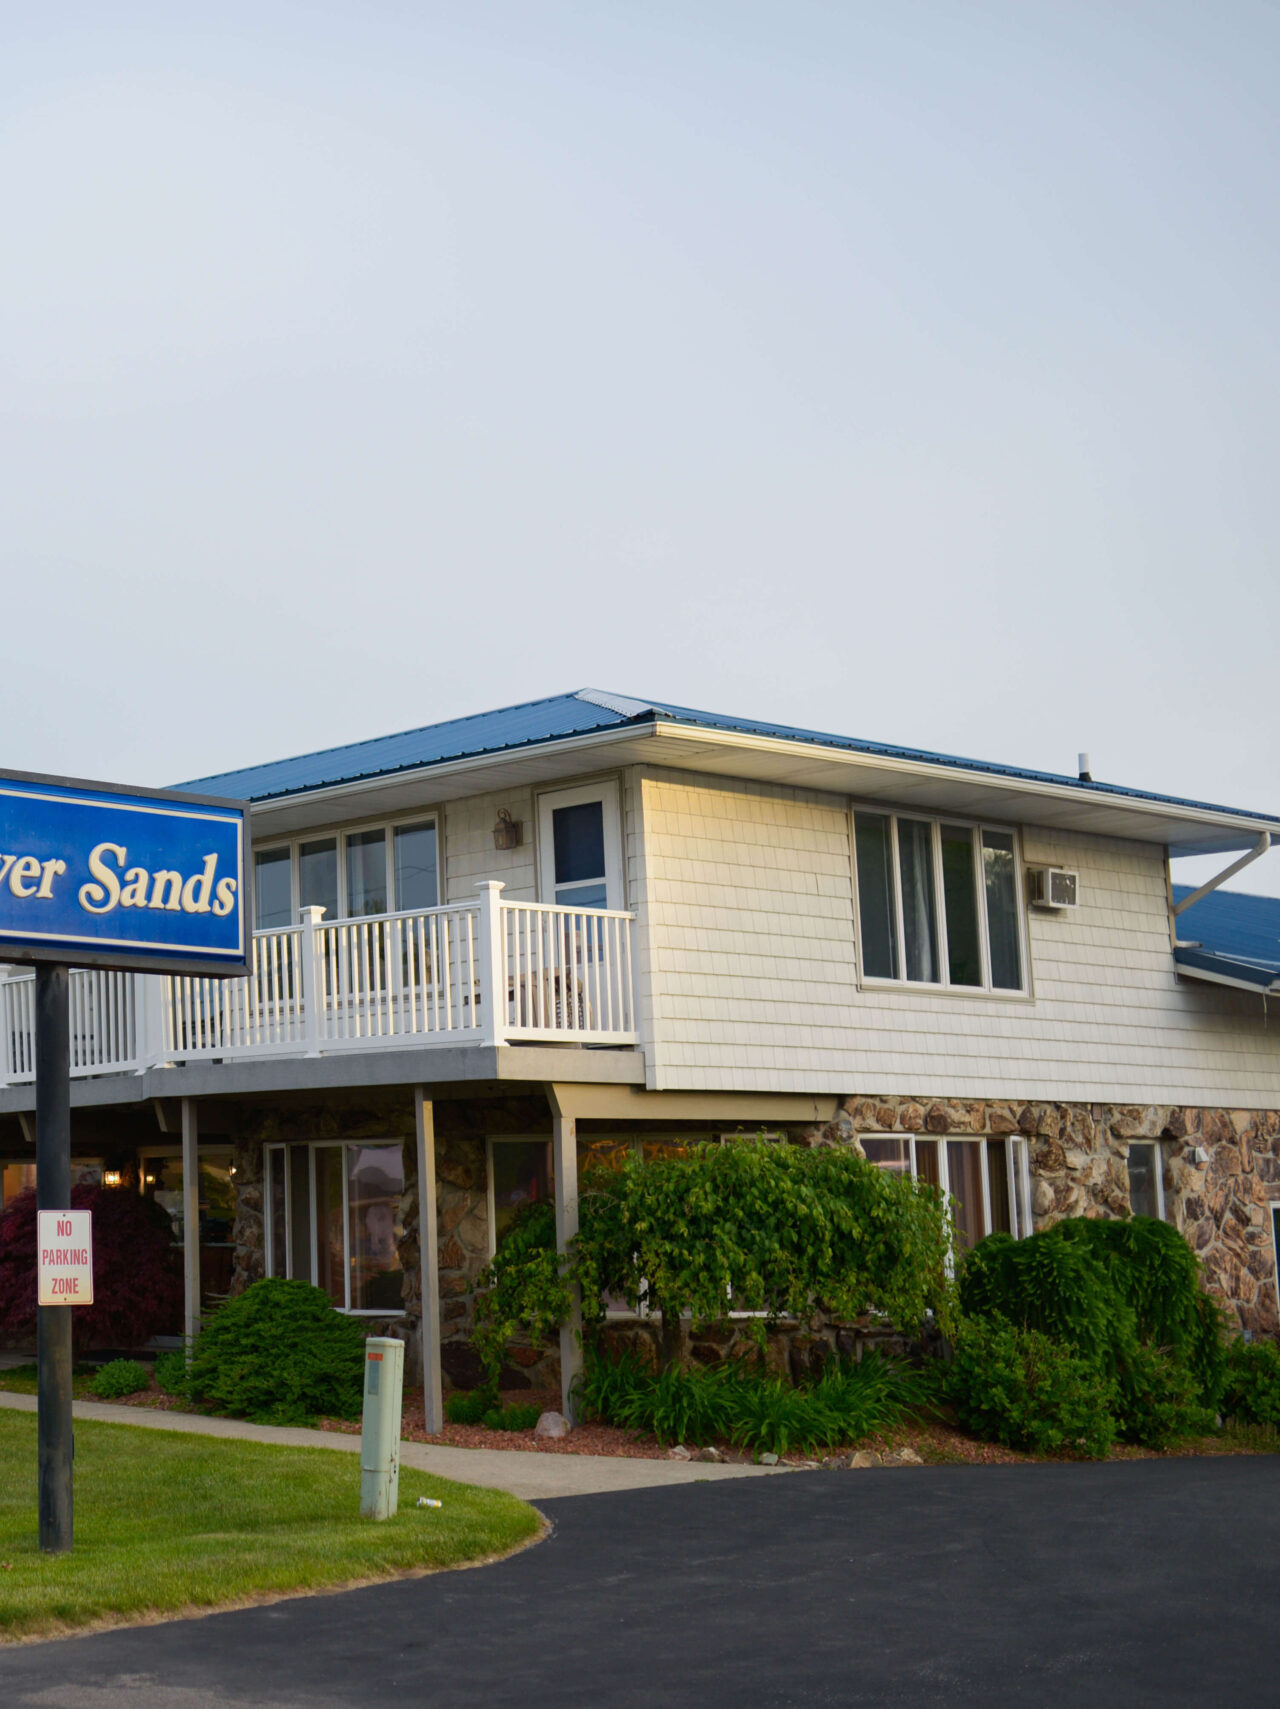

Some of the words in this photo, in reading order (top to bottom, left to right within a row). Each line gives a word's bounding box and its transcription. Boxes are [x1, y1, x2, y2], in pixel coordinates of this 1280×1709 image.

[78, 842, 238, 917] Sands
[57, 1220, 73, 1237] NO
[42, 1248, 88, 1266] PARKING
[51, 1277, 80, 1295] ZONE
